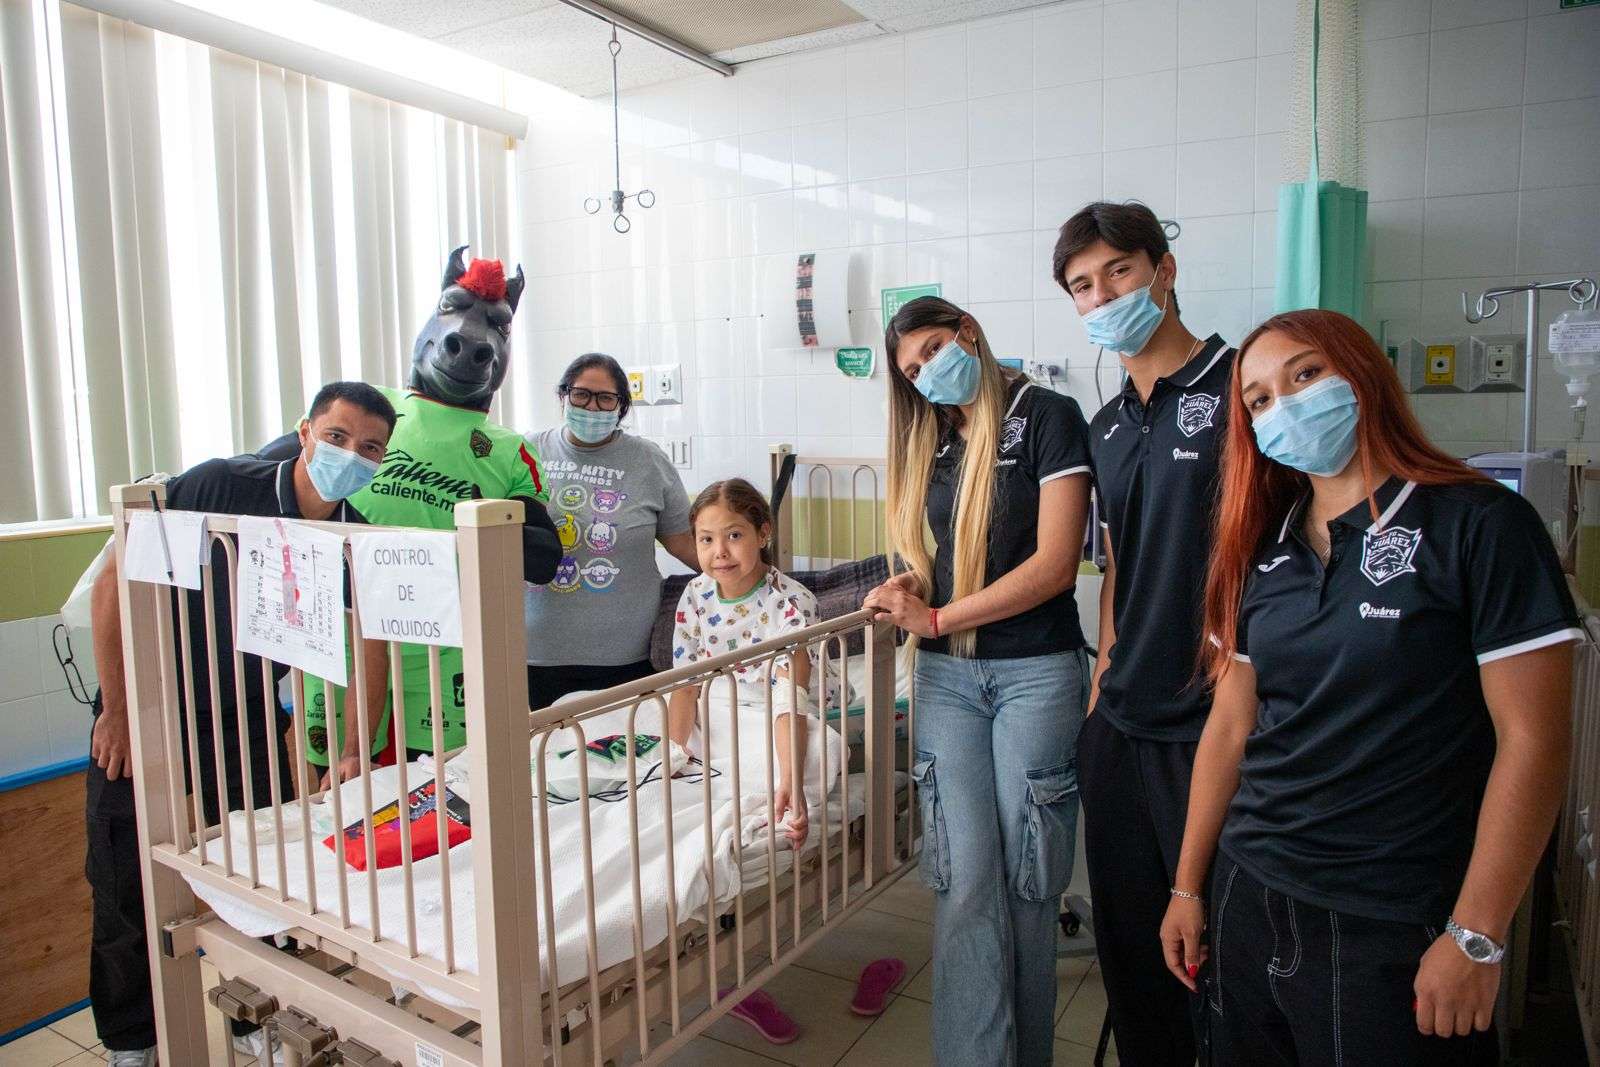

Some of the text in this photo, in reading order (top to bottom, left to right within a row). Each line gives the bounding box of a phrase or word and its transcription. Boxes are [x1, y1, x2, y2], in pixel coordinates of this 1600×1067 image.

[581, 464, 625, 480] KITTY
[371, 481, 455, 513] caliente.m
[374, 548, 434, 566] CONTROL
[398, 585, 415, 601] DE
[381, 619, 441, 638] LIQUIDOS
